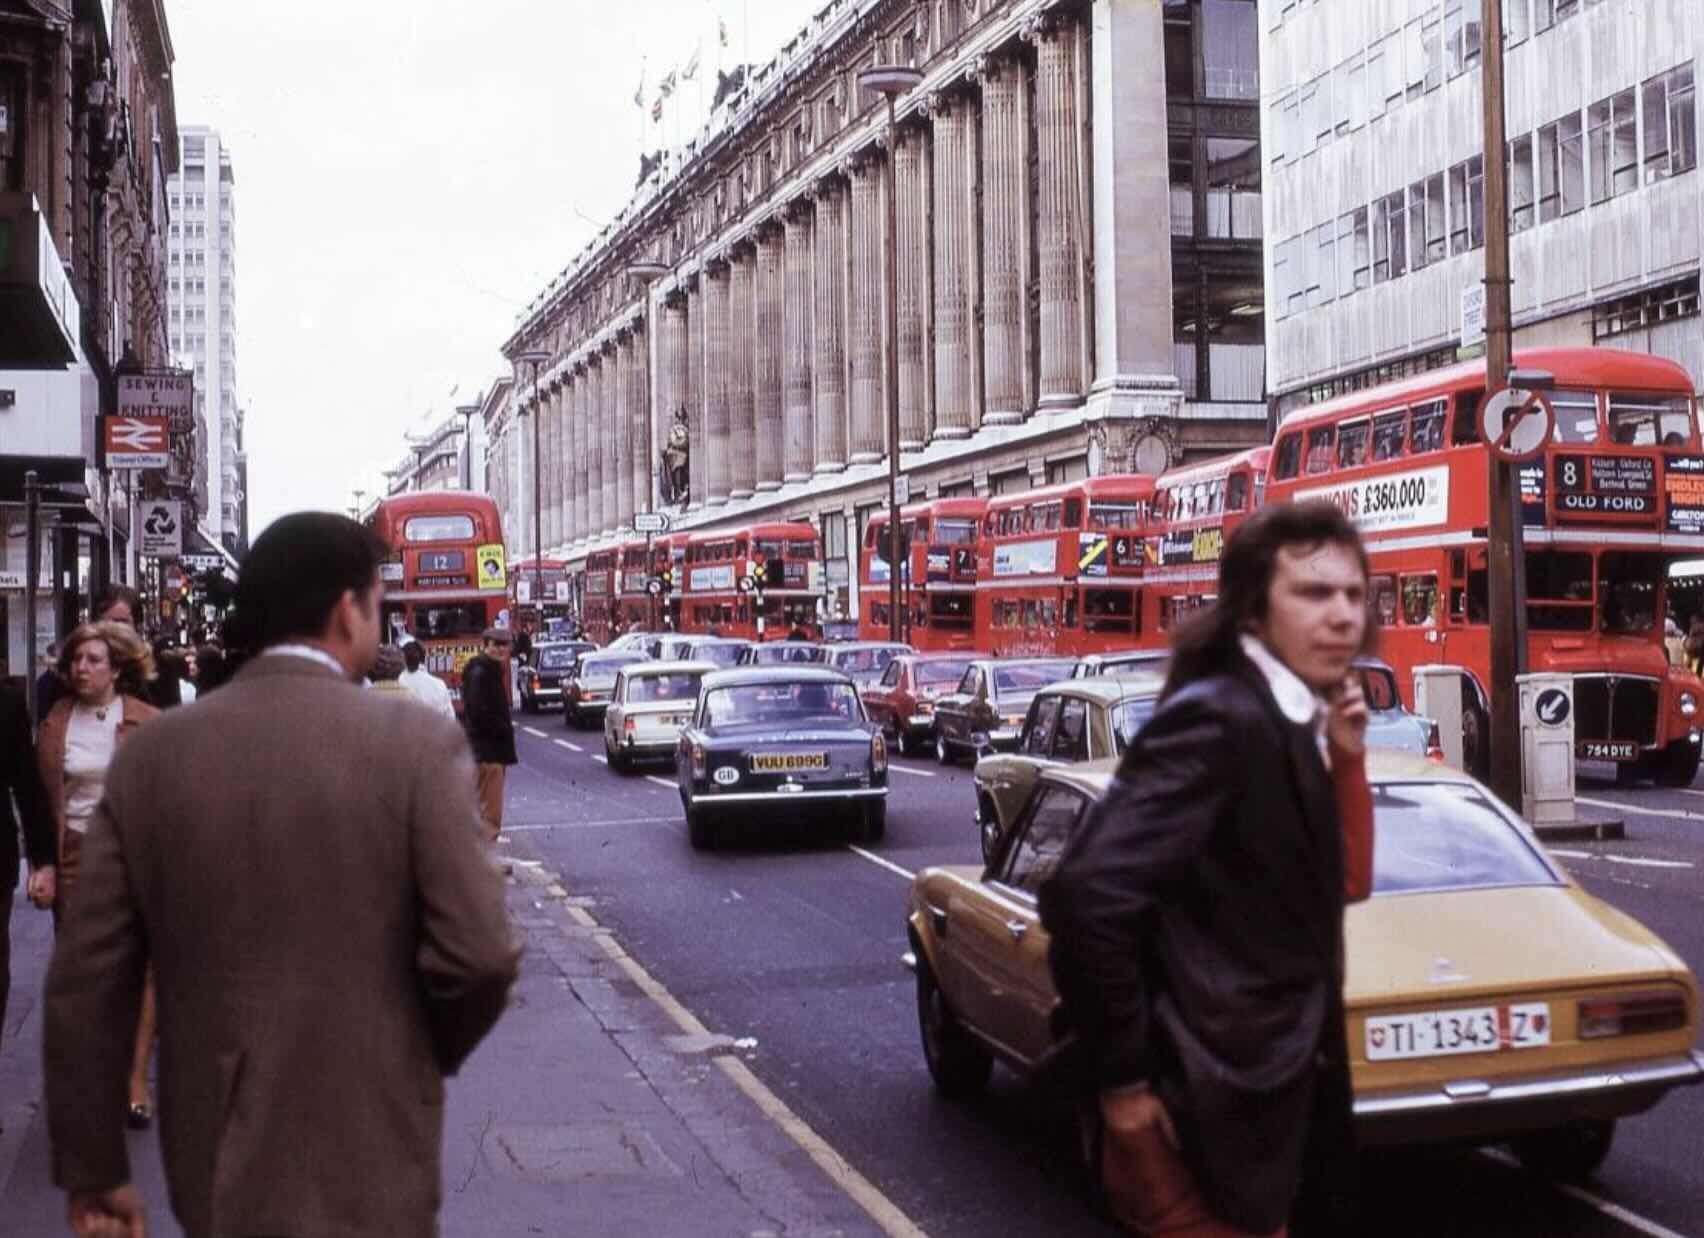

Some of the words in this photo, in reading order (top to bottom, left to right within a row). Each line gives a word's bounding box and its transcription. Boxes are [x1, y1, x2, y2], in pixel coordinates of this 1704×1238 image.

[126, 379, 185, 391] SEWING
[121, 405, 188, 416] KNITTING
[112, 455, 136, 465] Travel
[137, 455, 162, 464] Office
[1563, 461, 1577, 486] 8
[1363, 477, 1426, 514] £360,000
[1565, 495, 1597, 508] OLD
[1604, 496, 1645, 511] FORD
[1116, 540, 1126, 555] 6
[434, 556, 448, 570] 12
[959, 551, 967, 564] 7
[1611, 744, 1633, 757] DYE
[756, 756, 784, 769] VUU
[718, 770, 734, 781] GB
[1511, 1012, 1528, 1041] Z
